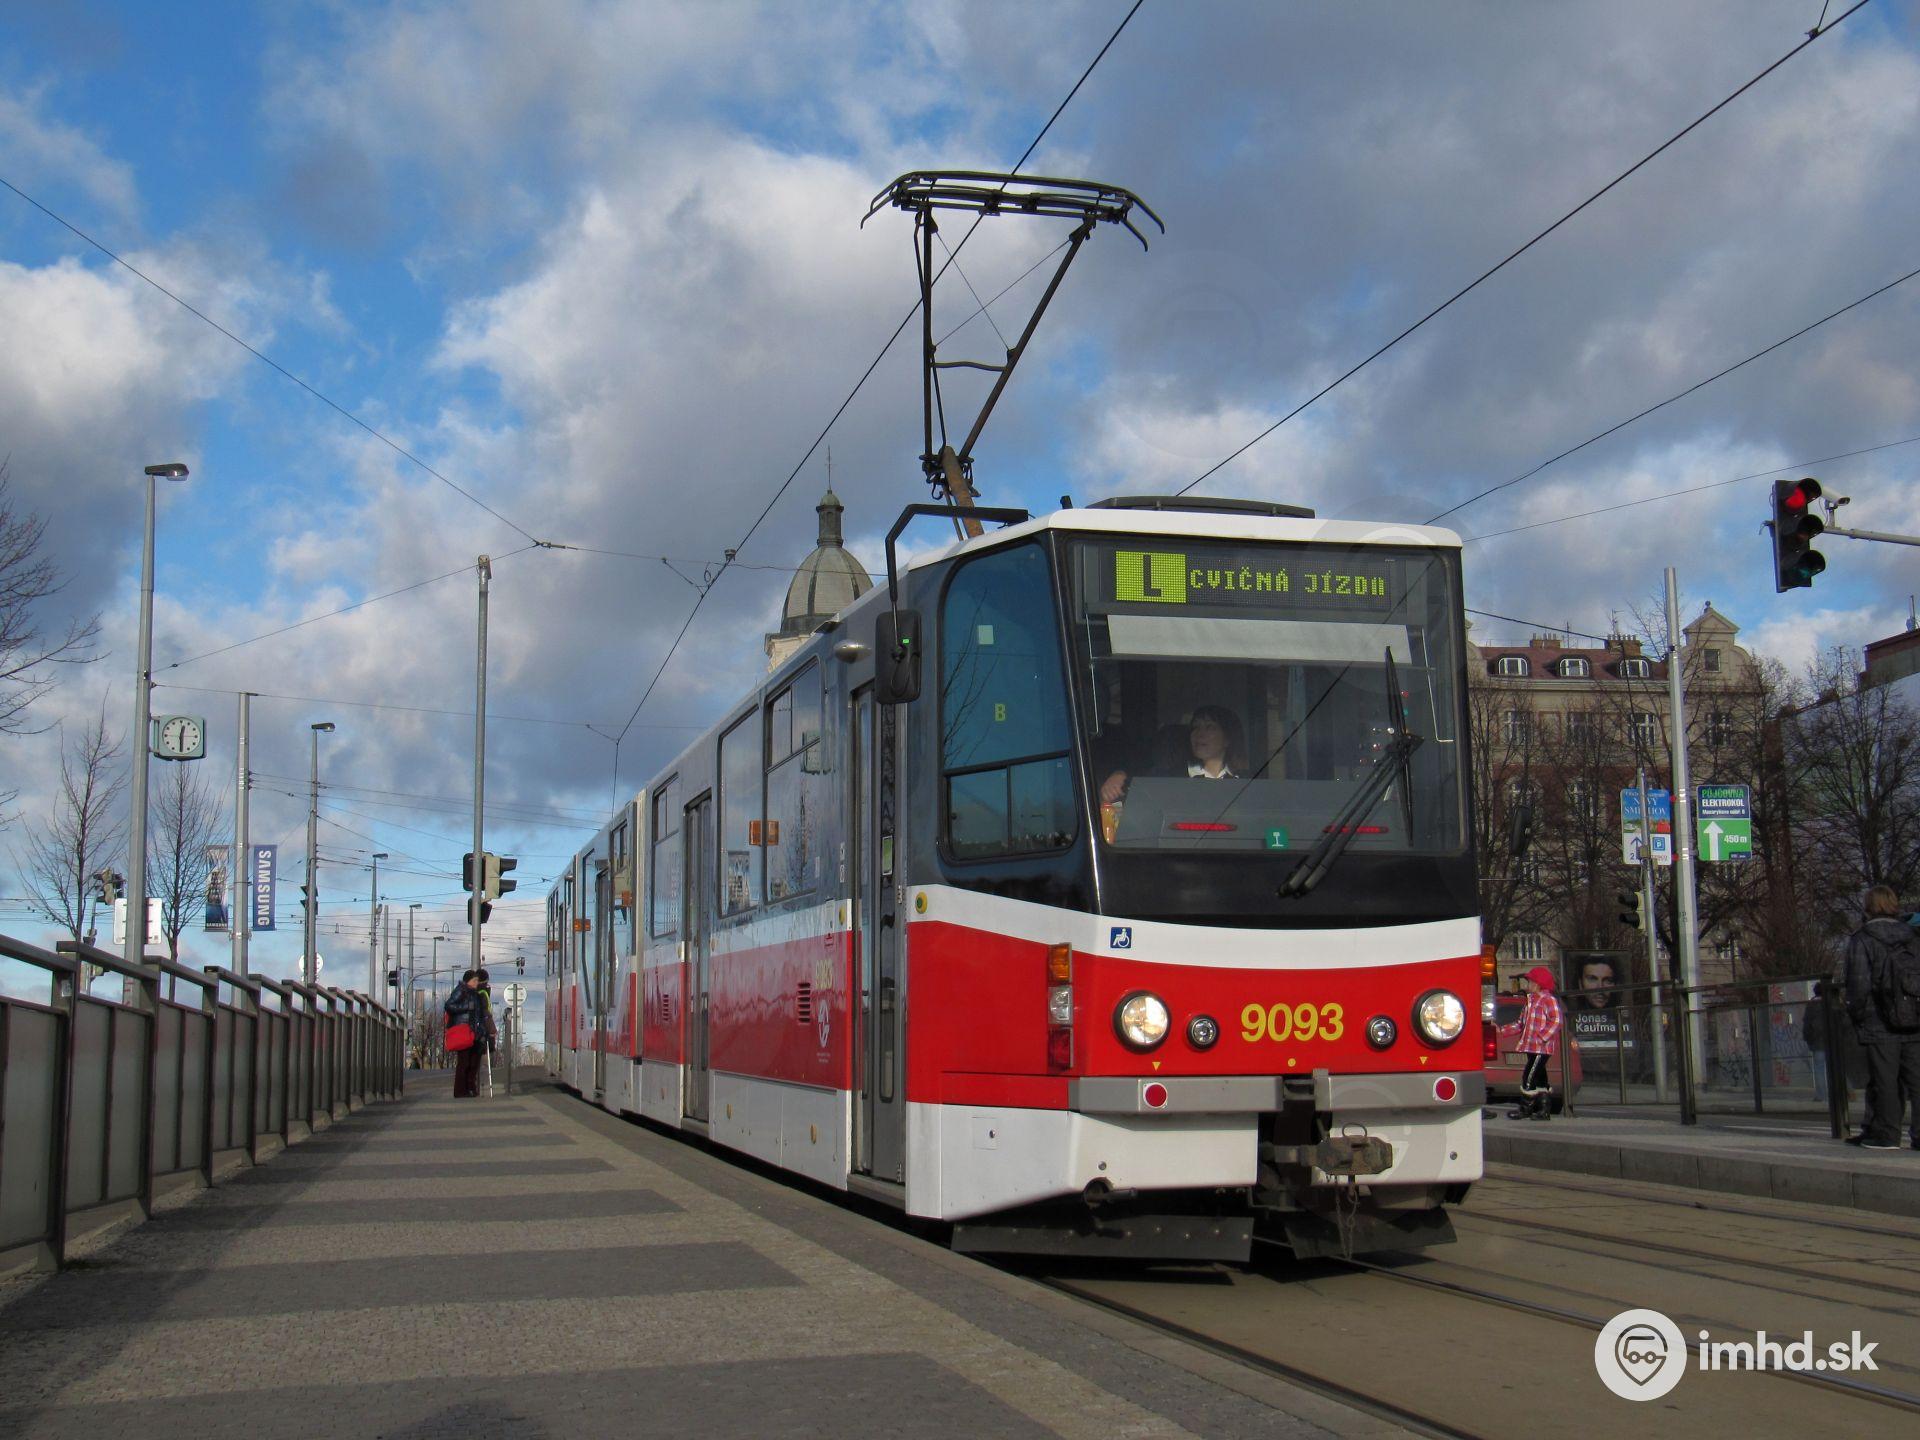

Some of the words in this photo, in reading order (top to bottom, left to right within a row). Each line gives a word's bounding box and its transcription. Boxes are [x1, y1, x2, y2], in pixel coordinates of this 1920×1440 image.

[1143, 553, 1162, 598] L
[1190, 567, 1289, 592] CVIČNÁ
[994, 703, 1006, 721] B
[1702, 799, 1745, 807] ELEKTROKOL
[1724, 835, 1739, 844] 450
[1740, 836, 1747, 844] m
[257, 850, 272, 926] SAMSUNG
[1241, 1002, 1344, 1042] 9093
[1575, 1013, 1608, 1023] Jonas
[1575, 1023, 1630, 1032] Kaufman
